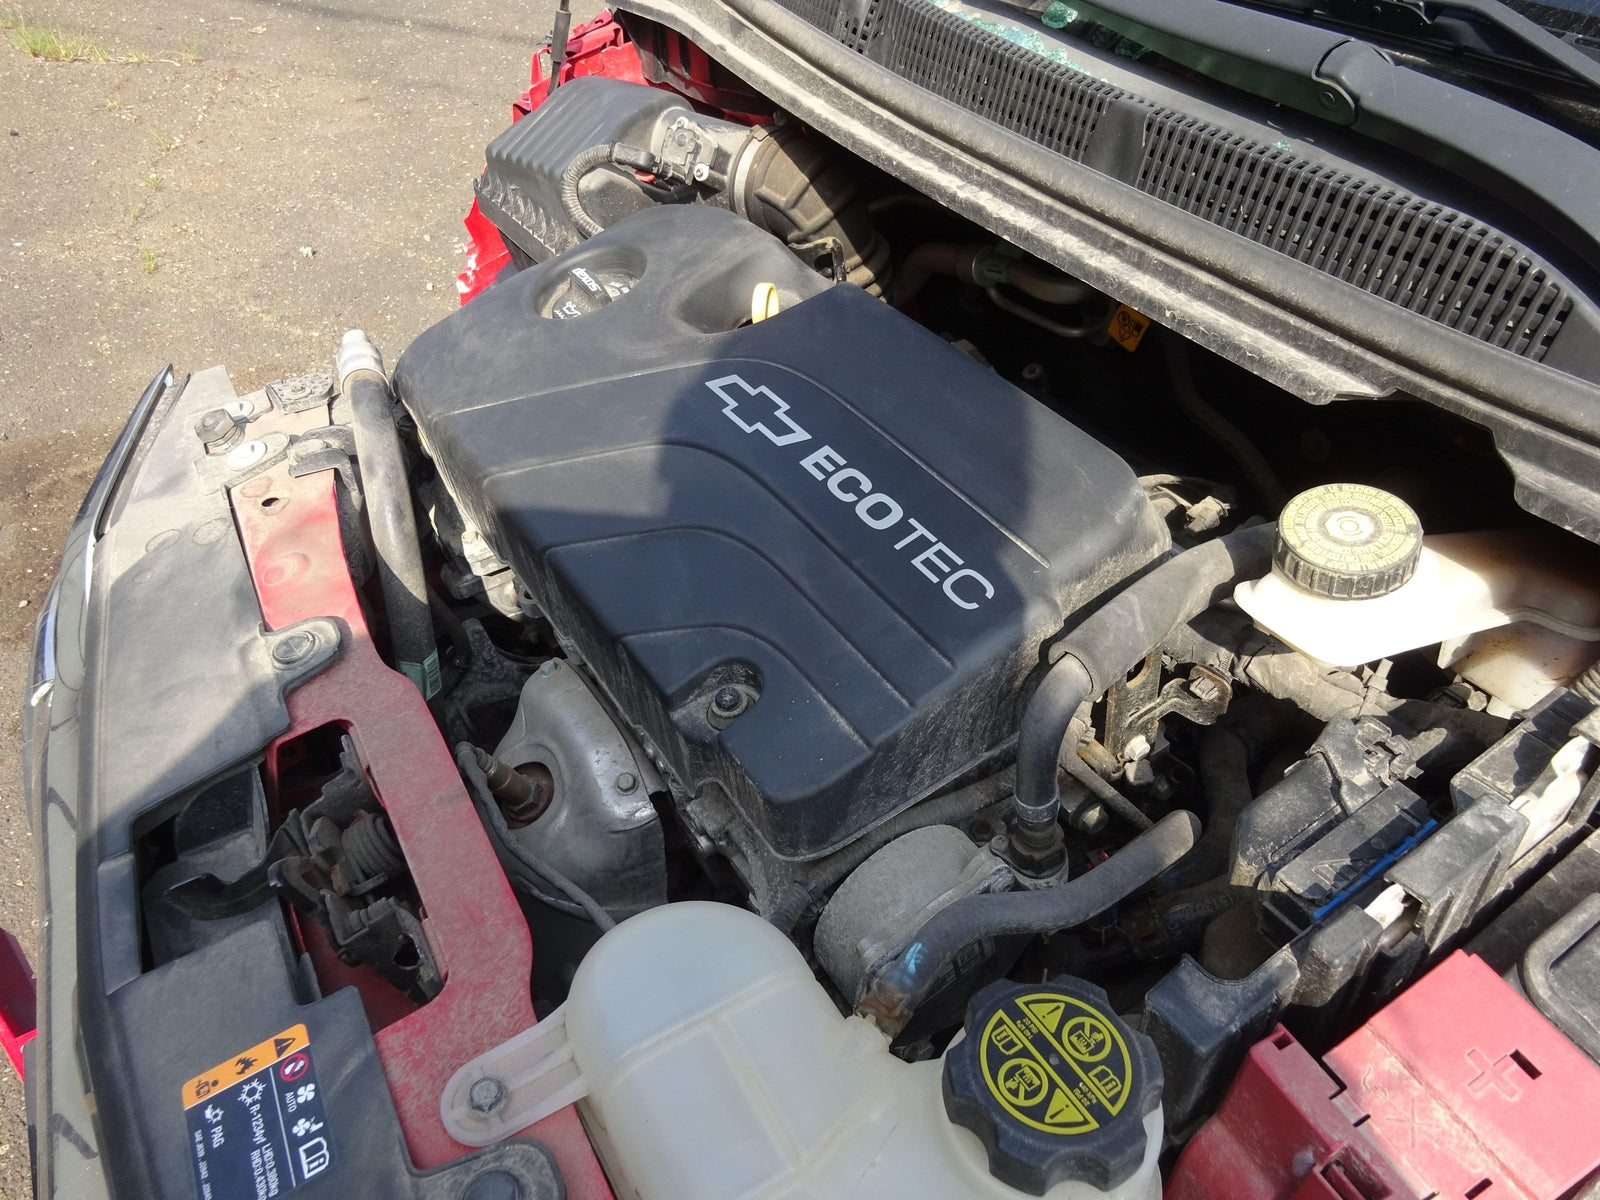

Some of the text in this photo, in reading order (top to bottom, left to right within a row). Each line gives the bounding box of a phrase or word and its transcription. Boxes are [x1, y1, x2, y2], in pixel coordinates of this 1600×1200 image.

[799, 445, 995, 610] ECOTEC
[285, 1092, 298, 1113] AUTO
[211, 1124, 225, 1149] PAG
[250, 1103, 267, 1145] R-1234yf
[262, 1142, 280, 1198] LHD:0.380kg
